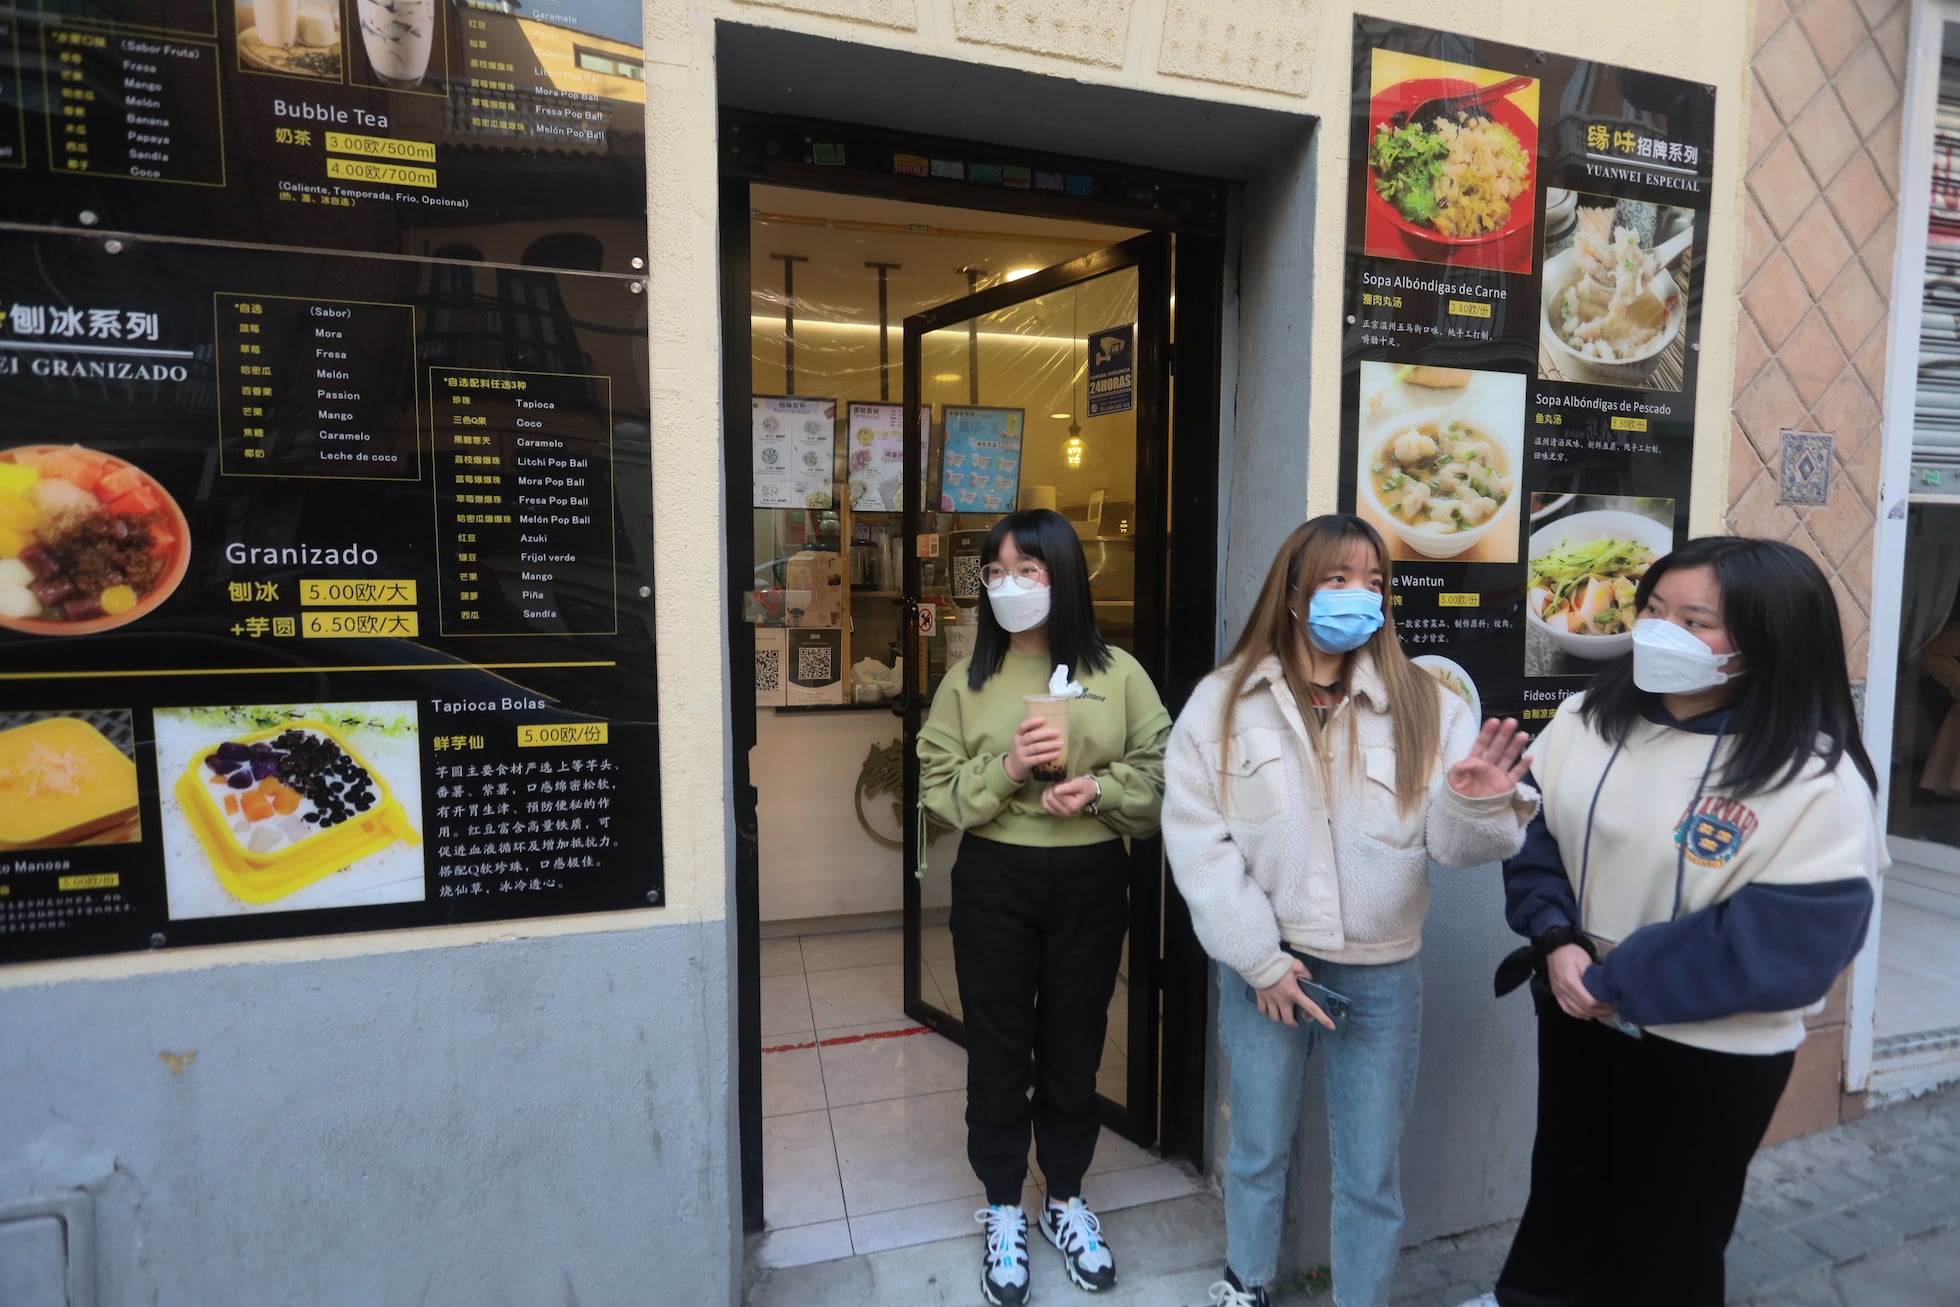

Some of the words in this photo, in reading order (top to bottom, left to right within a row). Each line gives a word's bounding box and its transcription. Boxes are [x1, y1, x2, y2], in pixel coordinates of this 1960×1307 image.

[123, 60, 157, 73] Fresa
[124, 78, 162, 92] Mango
[535, 86, 559, 97] Mora
[561, 90, 579, 101] Pop
[581, 93, 599, 102] Ball
[125, 96, 160, 109] Melón
[273, 99, 349, 124] Bubble
[354, 109, 389, 129] Tea
[535, 106, 562, 116] Fresa
[564, 109, 583, 120] Pop
[585, 111, 603, 121] Ball
[127, 114, 169, 127] Banana
[128, 131, 170, 145] Papaya
[275, 127, 311, 147] 奶茶
[536, 124, 565, 136] Melón
[566, 128, 584, 139] Pop
[587, 130, 605, 140] Ball
[329, 136, 435, 160] 3.00欧/500ml
[130, 166, 160, 178] Coco
[331, 162, 436, 186] 4.00欧/700ml
[1586, 163, 1641, 183] YUANWEI
[1646, 174, 1700, 193] ESPECIAL
[421, 196, 469, 209] Opcional)
[1363, 272, 1391, 288] Sopa
[1394, 276, 1456, 295] Albóndigas
[1459, 282, 1472, 296] de
[1475, 285, 1507, 300] Carne
[310, 306, 351, 319] (Sabor)
[0, 299, 159, 341] 刨冰系列
[315, 329, 343, 339] Mora
[316, 349, 347, 360] Fresa
[31, 358, 188, 382] GRANIZADO
[316, 369, 349, 380] Melón
[317, 390, 360, 400] Passion
[516, 399, 555, 410] Tapioca
[1536, 393, 1561, 408] Sopa
[1563, 395, 1618, 413] Albóndigas
[1620, 400, 1631, 412] de
[1633, 401, 1672, 416] Pescado
[318, 410, 353, 421] Mango
[516, 418, 542, 428] Coco
[319, 431, 370, 441] Caramelo
[517, 438, 564, 448] Caramelo
[320, 451, 353, 461] Leche
[356, 452, 369, 461] de
[372, 453, 398, 462] coco
[518, 458, 546, 466] Litchi
[548, 458, 567, 469] Pop
[570, 459, 588, 468] Ball
[518, 477, 543, 486] Mora
[545, 477, 564, 488] Pop
[566, 478, 585, 487] Ball
[519, 496, 547, 505] Fresa
[549, 497, 568, 507] Pop
[570, 497, 589, 506] Ball
[519, 515, 549, 524] Melón
[551, 516, 569, 526] Pop
[572, 516, 591, 525] Ball
[520, 534, 548, 543] Azuki
[225, 542, 378, 565] Granizado
[521, 553, 547, 563] Frijol
[548, 554, 576, 562] verde
[521, 572, 553, 582] Mango
[1401, 575, 1445, 588] Wantun
[228, 581, 279, 602] 刨冰
[309, 583, 409, 602] 5.00欧/大
[522, 591, 544, 600] Piña
[311, 615, 410, 634] 6.50欧/大
[1523, 690, 1556, 701] Fideos
[431, 698, 496, 714] Tapioca
[501, 696, 546, 711] Bolas
[524, 726, 601, 744] 5.00欧/份
[433, 735, 484, 751] 鲜芋仙
